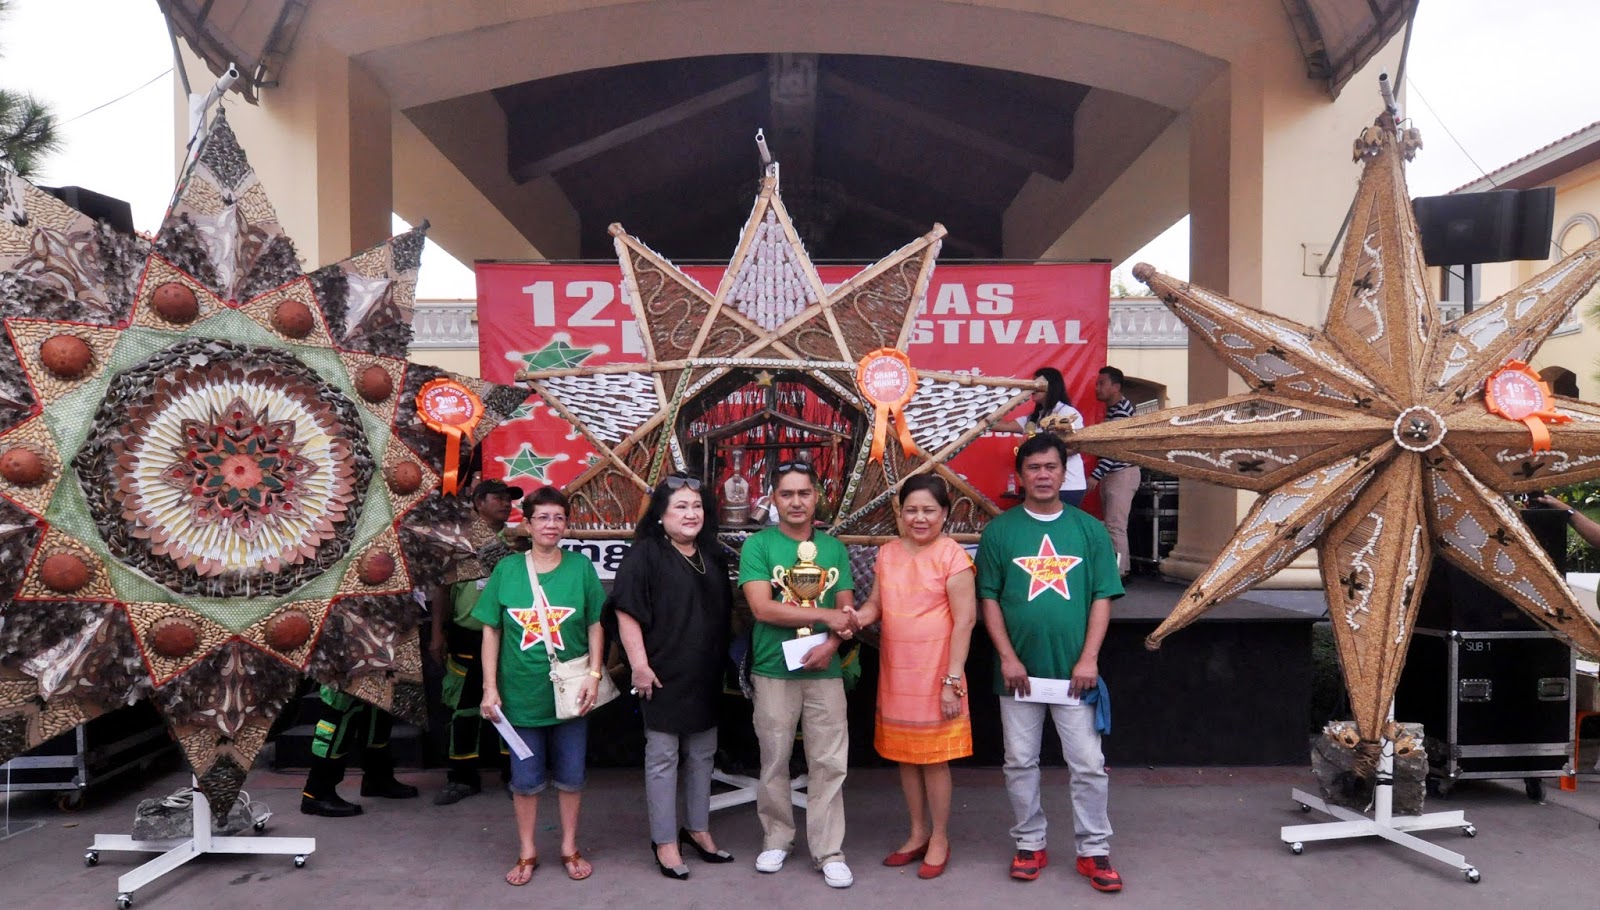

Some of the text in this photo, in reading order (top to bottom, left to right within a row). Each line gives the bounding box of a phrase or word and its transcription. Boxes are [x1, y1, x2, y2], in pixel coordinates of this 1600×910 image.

[874, 371, 898, 380] GRAND
[873, 379, 901, 388] WINNER
[1506, 382, 1525, 398] 1ST
[435, 395, 458, 409] 2ND
[1043, 557, 1071, 569] Parol
[1465, 642, 1491, 651] SUB 1
